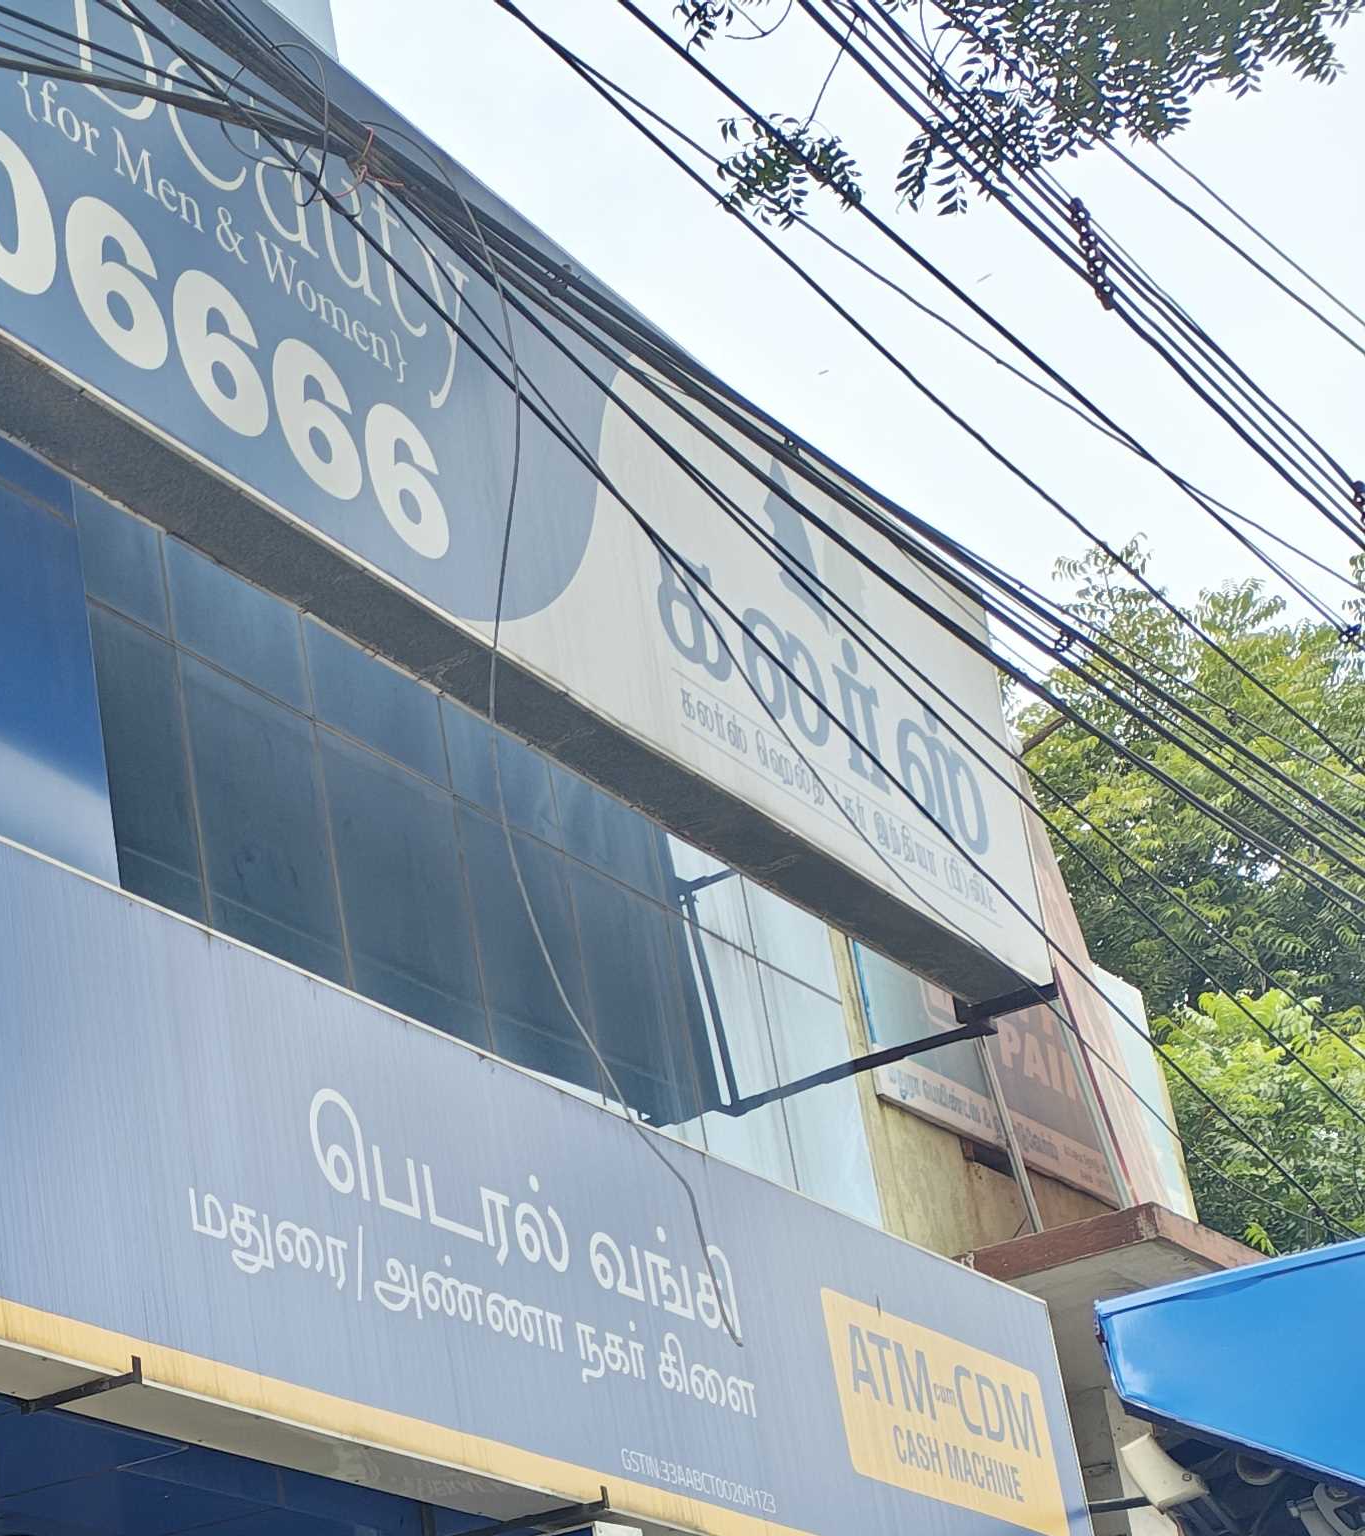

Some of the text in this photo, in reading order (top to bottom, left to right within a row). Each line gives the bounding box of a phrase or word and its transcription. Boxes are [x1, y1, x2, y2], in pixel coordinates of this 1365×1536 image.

[111, 126, 205, 233] Men
[215, 205, 249, 265] &
[255, 230, 408, 384] Women}
[188, 1187, 348, 1291] மதுரை
[373, 1254, 564, 1353] அண்ணா
[577, 1321, 646, 1383] நகர்
[658, 1332, 758, 1418] கிளை
[309, 1088, 743, 1339] பெடரல் வங்கி
[848, 1323, 939, 1422] ATM
[953, 1363, 1042, 1459] CDM
[893, 1424, 1025, 1503] CASH MACHINE
